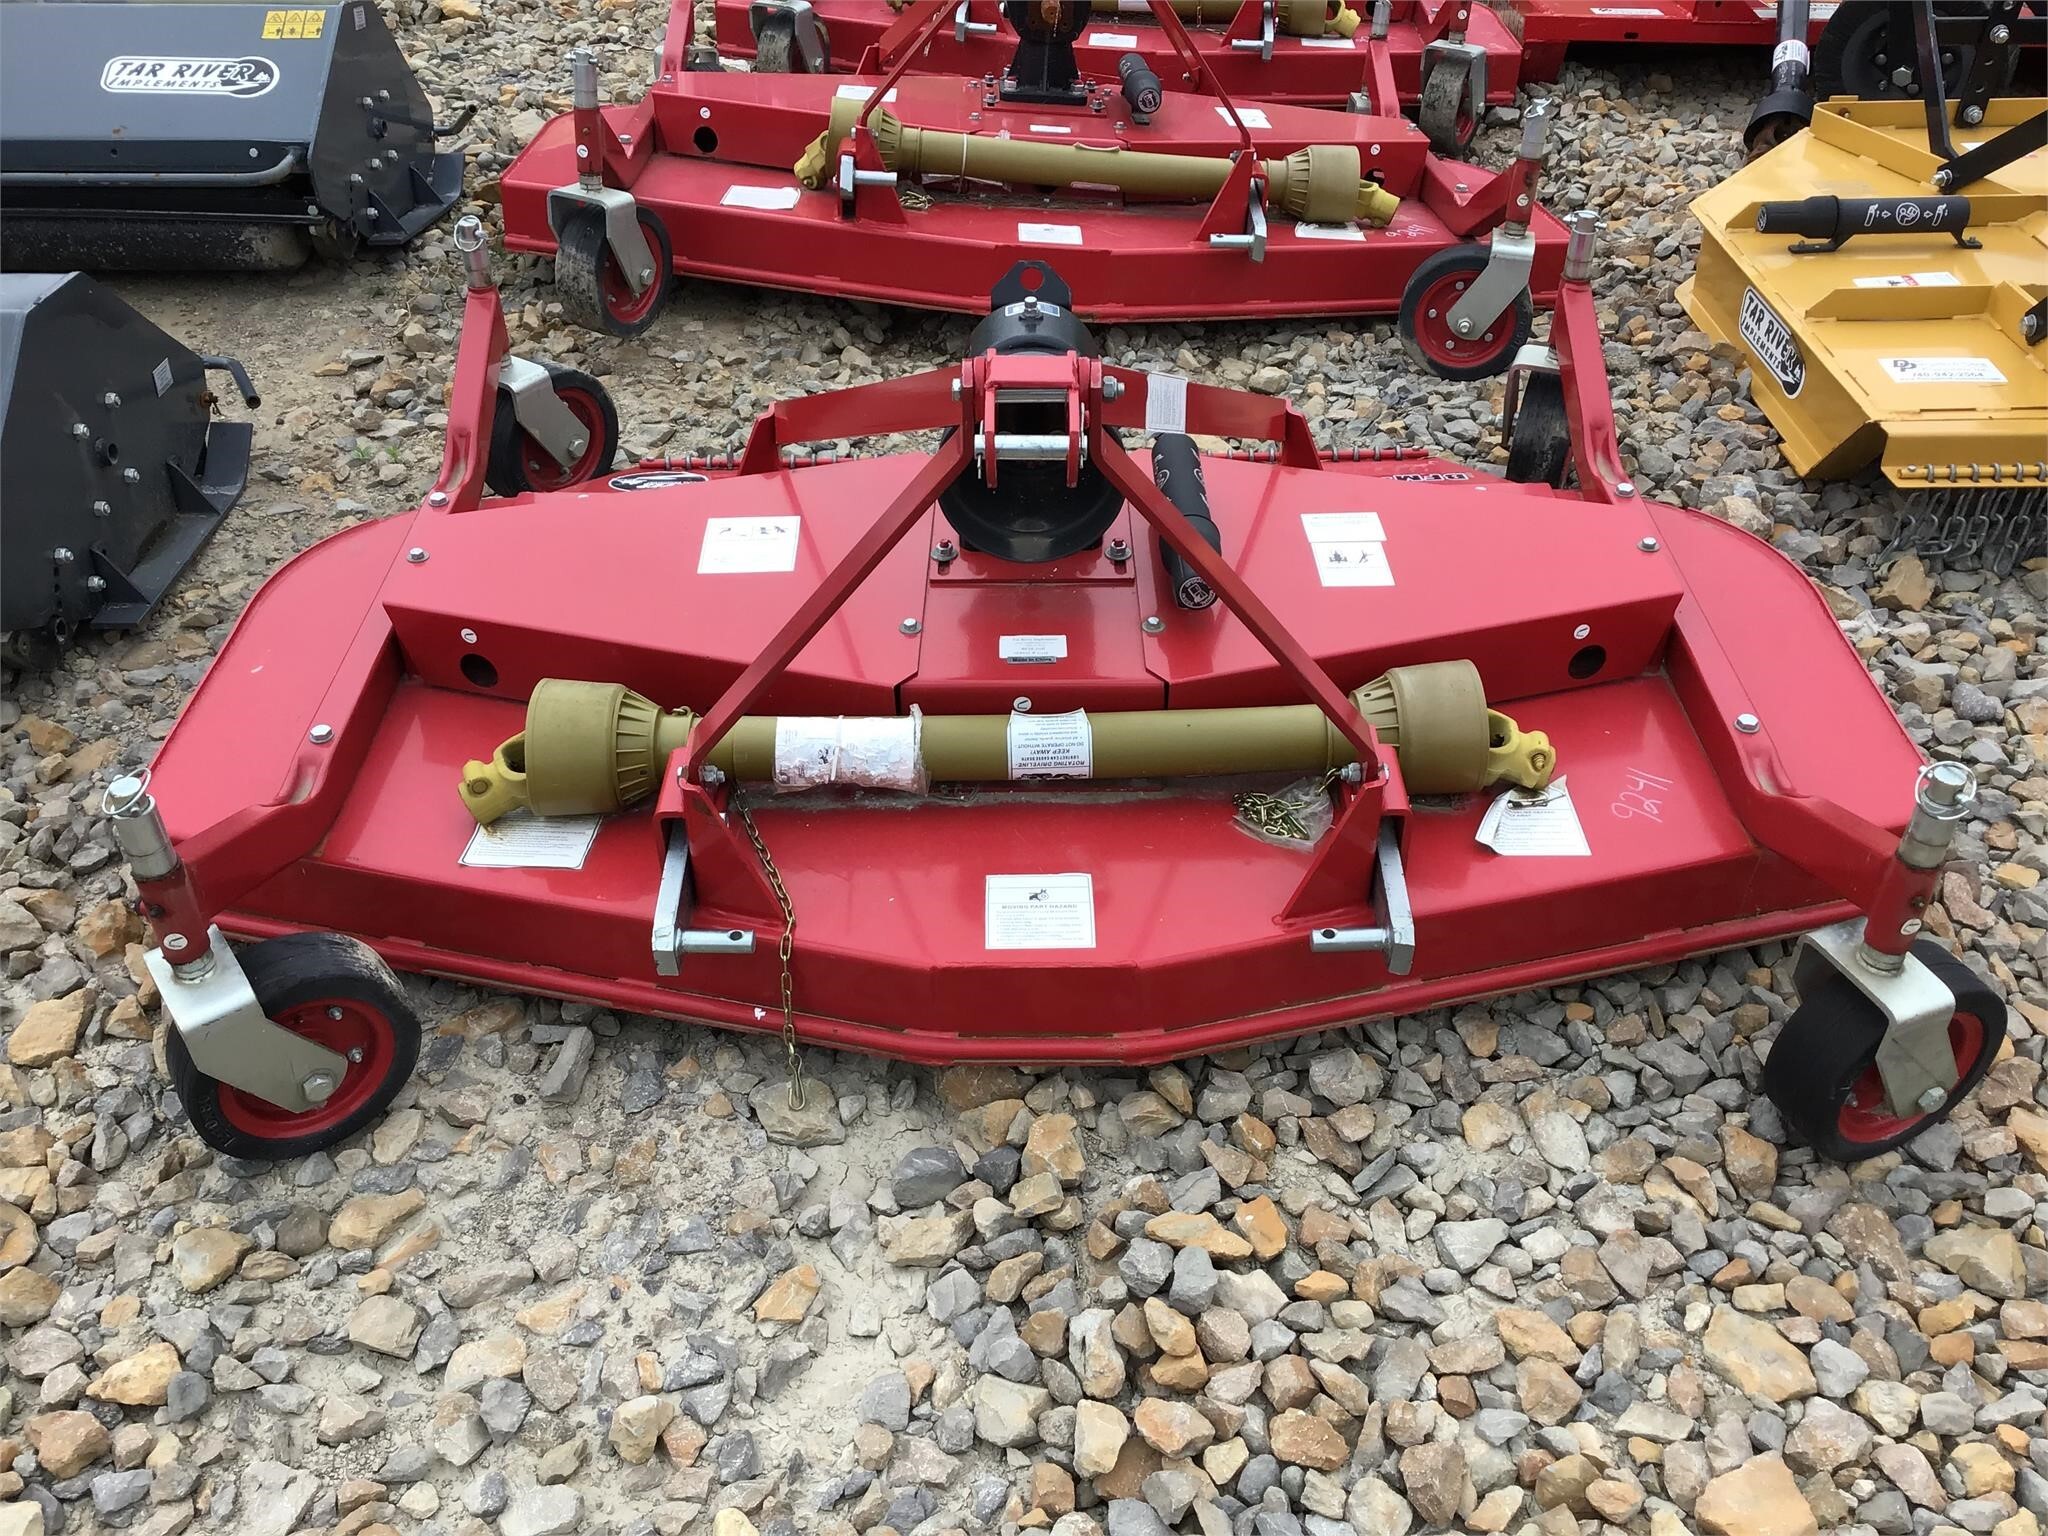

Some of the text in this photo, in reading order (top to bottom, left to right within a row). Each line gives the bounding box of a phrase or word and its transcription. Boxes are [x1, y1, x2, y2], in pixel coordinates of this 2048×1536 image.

[108, 77, 222, 89] IMPLEMENTS
[114, 62, 255, 81] TAR RIVER
[1740, 315, 1782, 370] IMPLEMENTS
[1745, 294, 1797, 371] TAR RIVER
